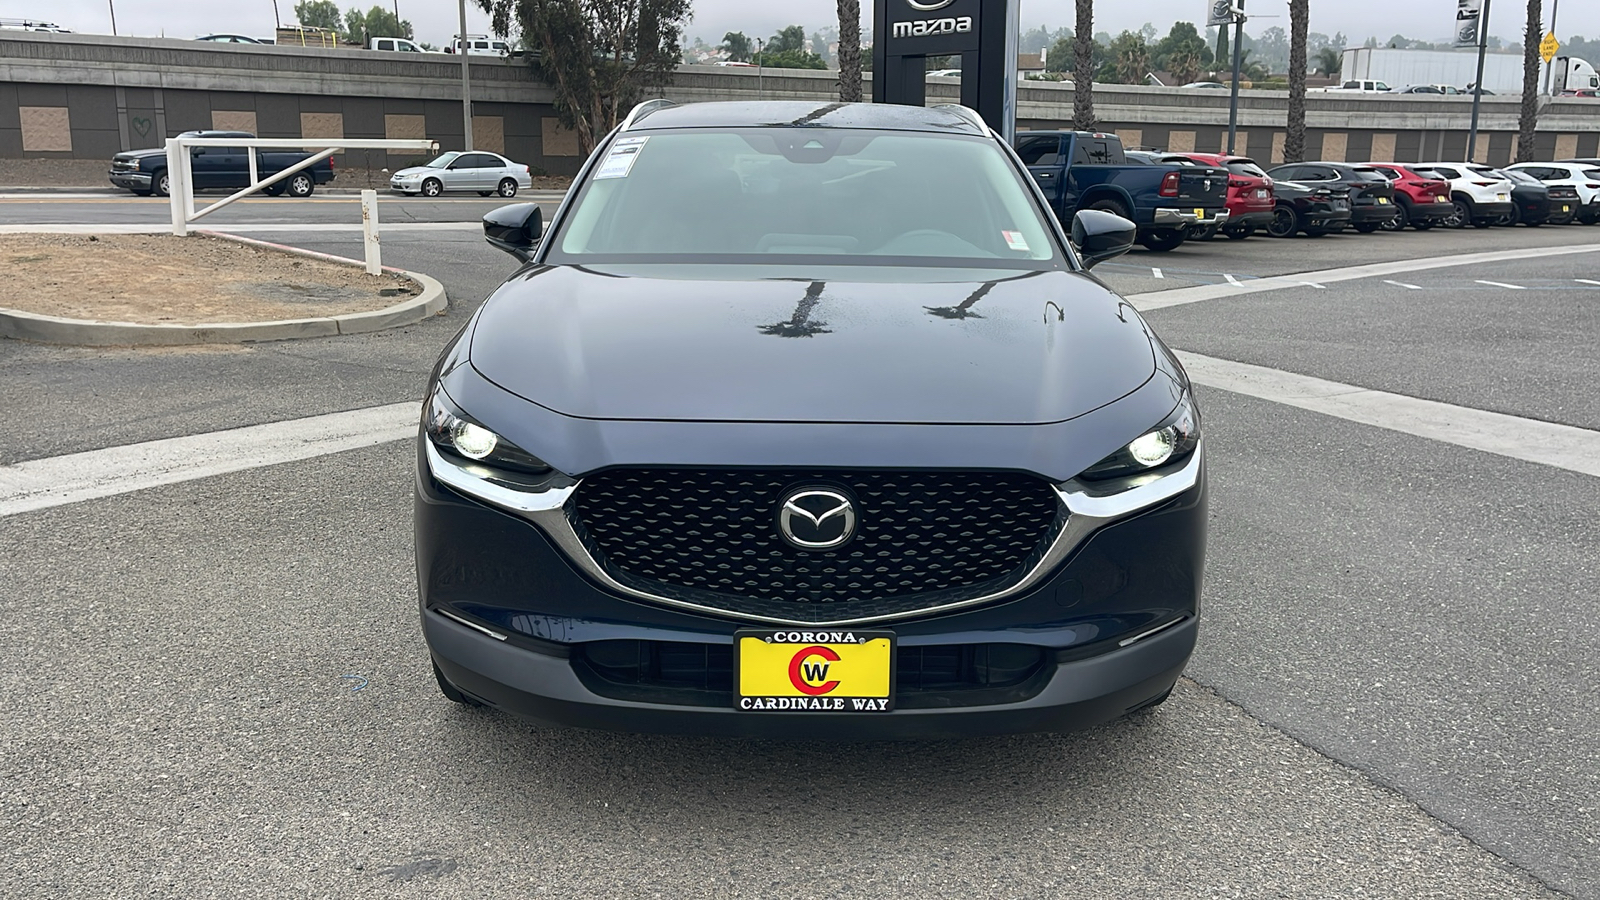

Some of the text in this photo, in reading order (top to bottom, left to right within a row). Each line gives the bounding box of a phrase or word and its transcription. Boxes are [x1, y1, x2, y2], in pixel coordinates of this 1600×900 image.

[773, 632, 857, 643] CORONA
[740, 698, 889, 711] CARDINALE WAY
